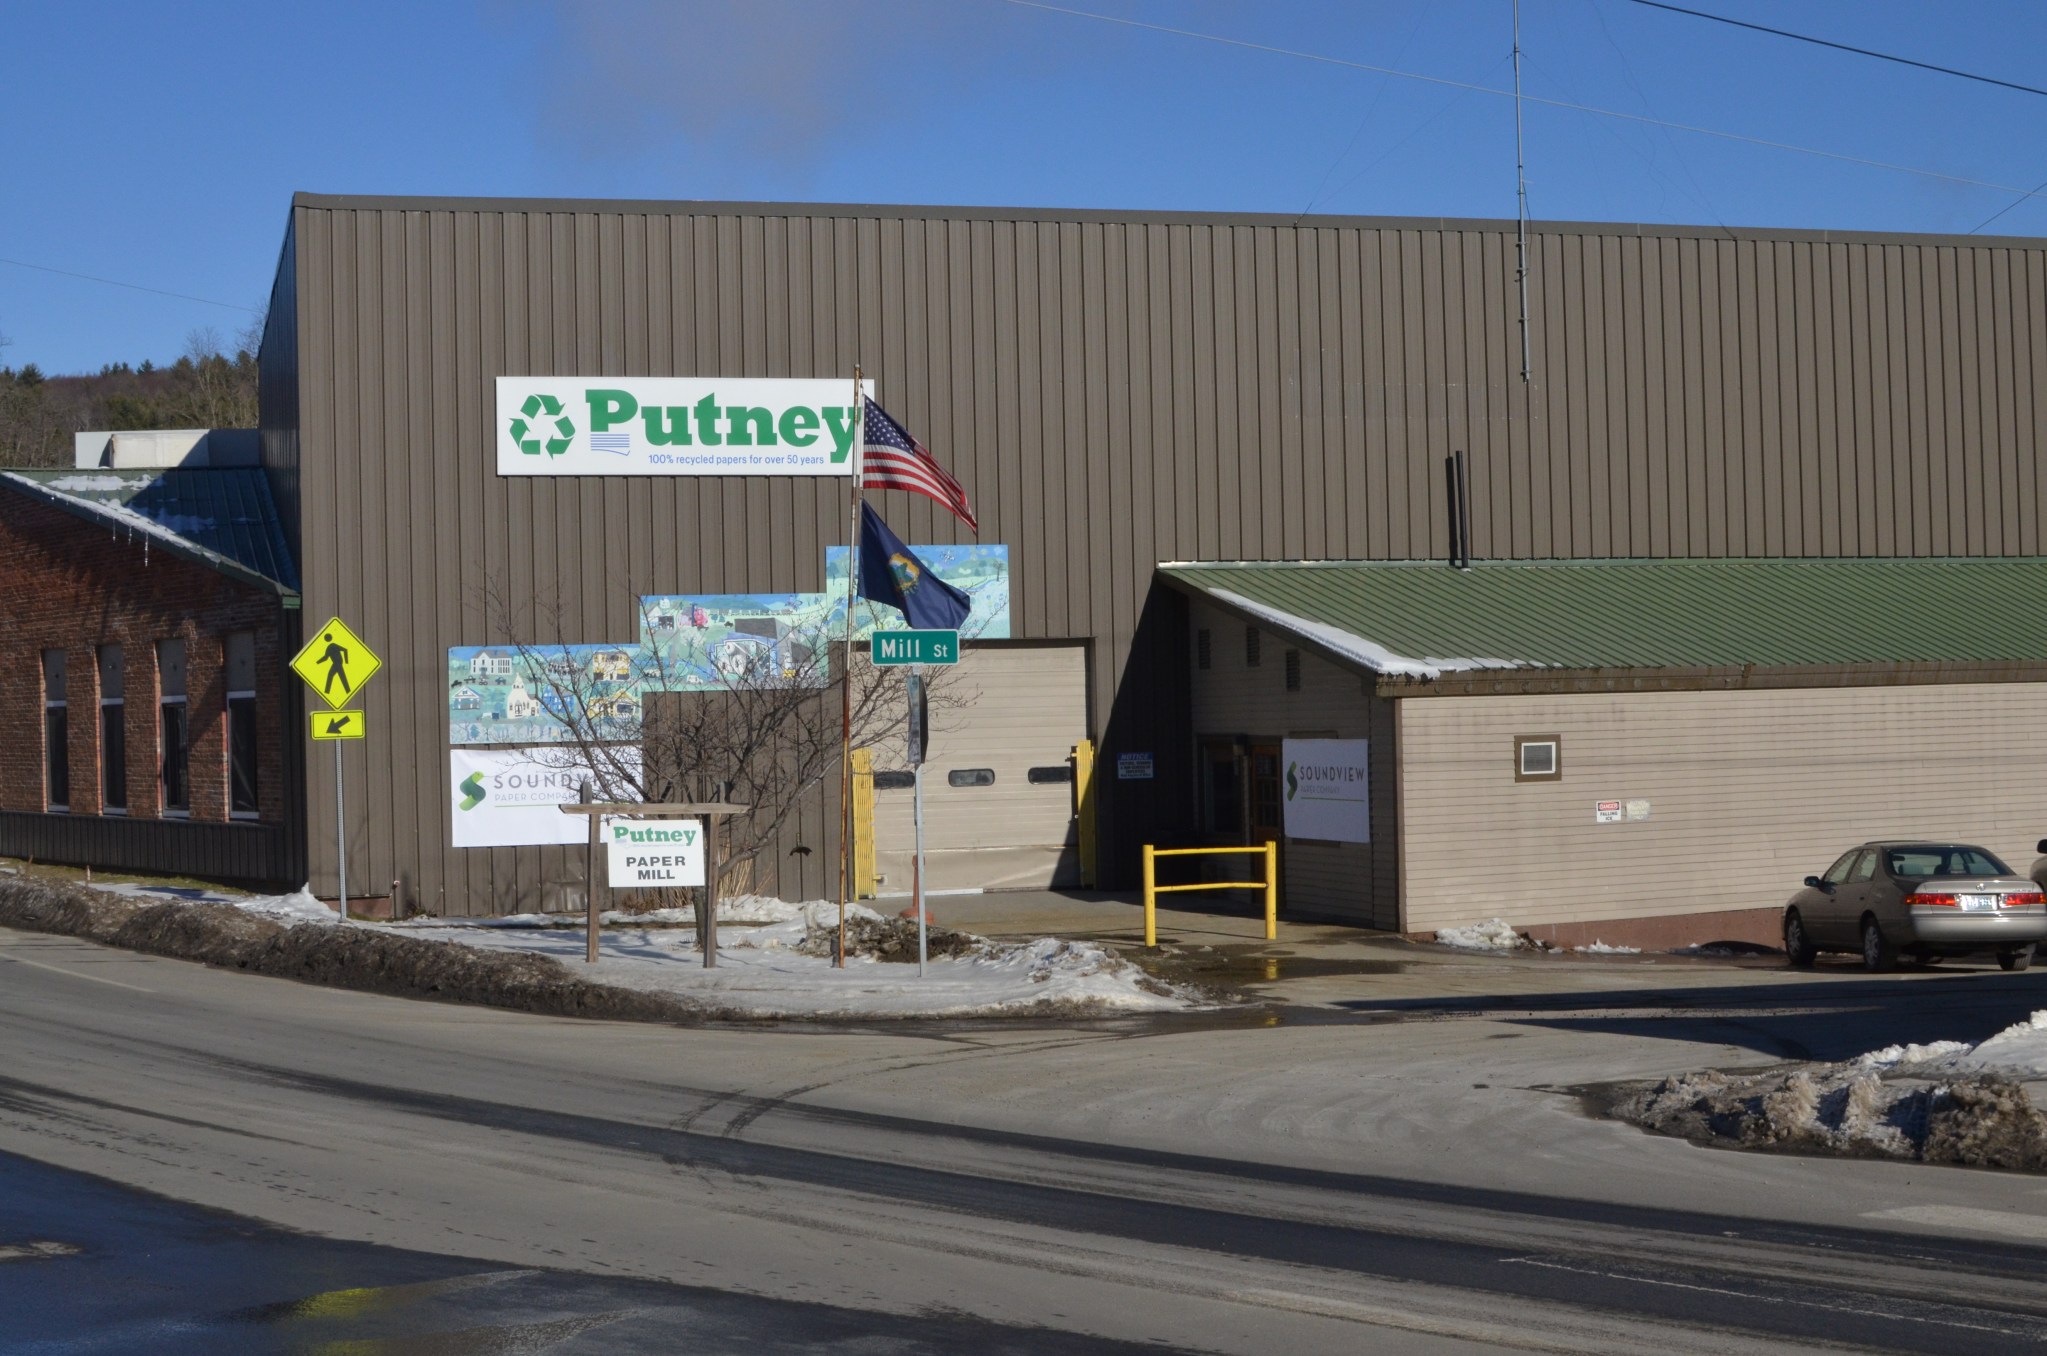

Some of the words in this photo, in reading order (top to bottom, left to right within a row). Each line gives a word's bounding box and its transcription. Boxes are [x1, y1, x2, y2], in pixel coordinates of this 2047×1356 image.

[585, 389, 862, 464] Putney
[648, 454, 674, 464] 100%
[676, 453, 714, 466] recycled
[716, 455, 747, 466] papers
[749, 454, 762, 464] for
[764, 456, 784, 464] over
[787, 454, 798, 464] 50
[800, 456, 824, 466] years
[881, 639, 920, 658] Mill
[933, 644, 948, 658] St
[1299, 766, 1365, 782] SOUNDVIEW
[494, 793, 527, 802] PAPER
[613, 826, 697, 846] Putney
[626, 856, 686, 867] PAPER
[637, 869, 675, 880] MILL
